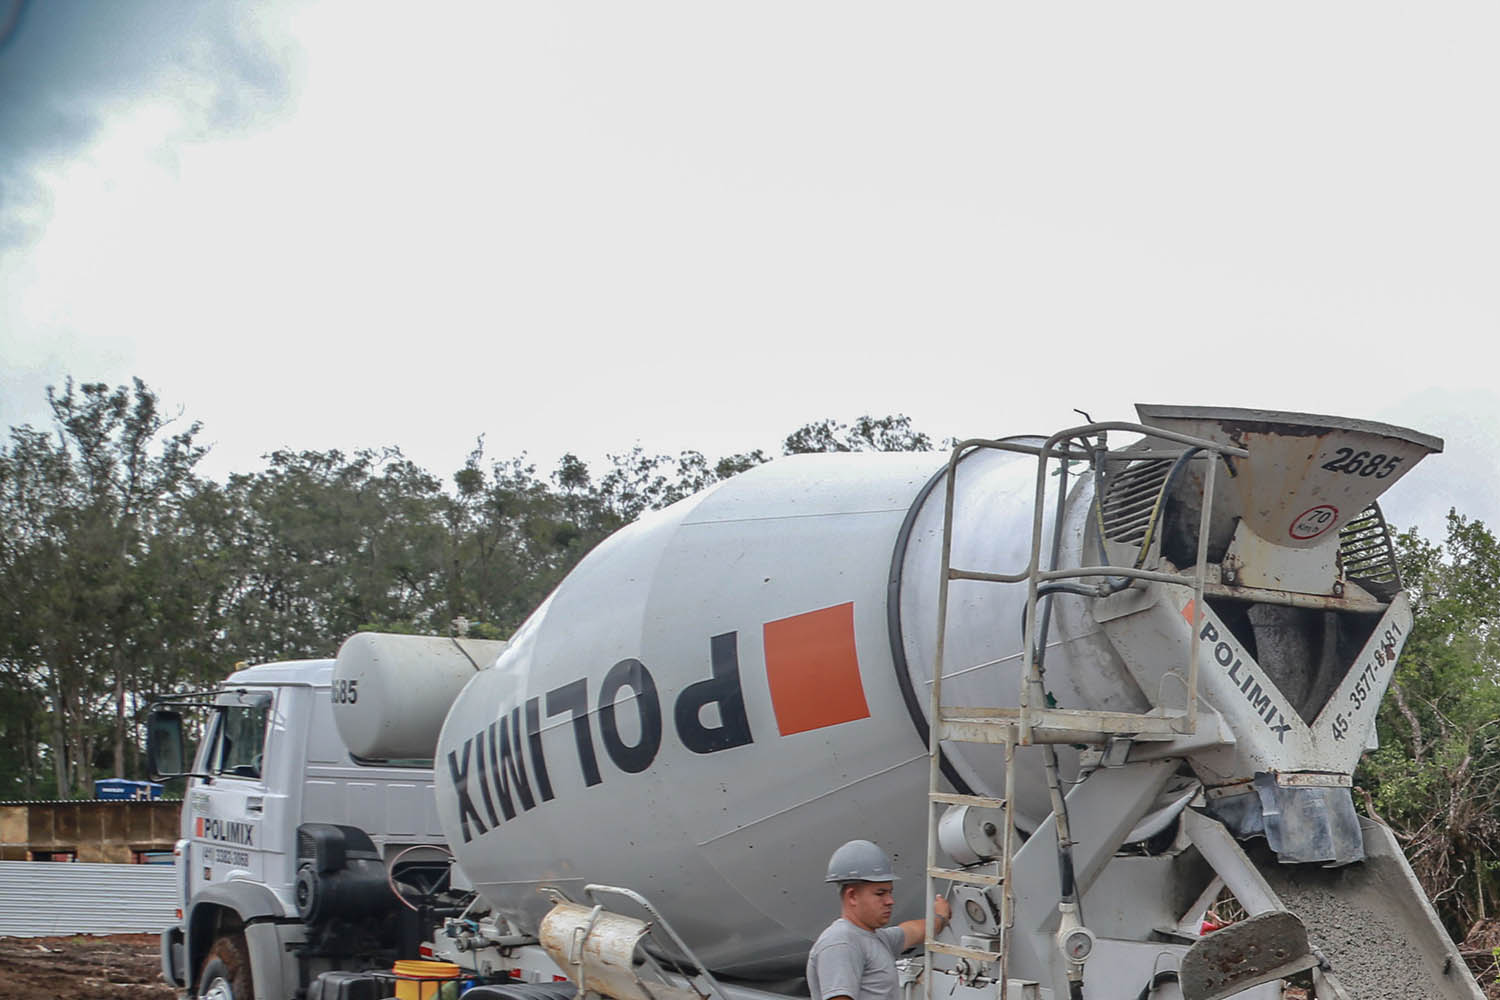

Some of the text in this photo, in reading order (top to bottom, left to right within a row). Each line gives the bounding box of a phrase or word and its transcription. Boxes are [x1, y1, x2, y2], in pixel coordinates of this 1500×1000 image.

[1321, 447, 1404, 479] 2685
[1307, 510, 1332, 524] 70
[1200, 621, 1292, 744] POLIMIX
[447, 630, 754, 844] POLIMIX
[1331, 713, 1349, 742] 45
[204, 818, 254, 846] POLIMIX
